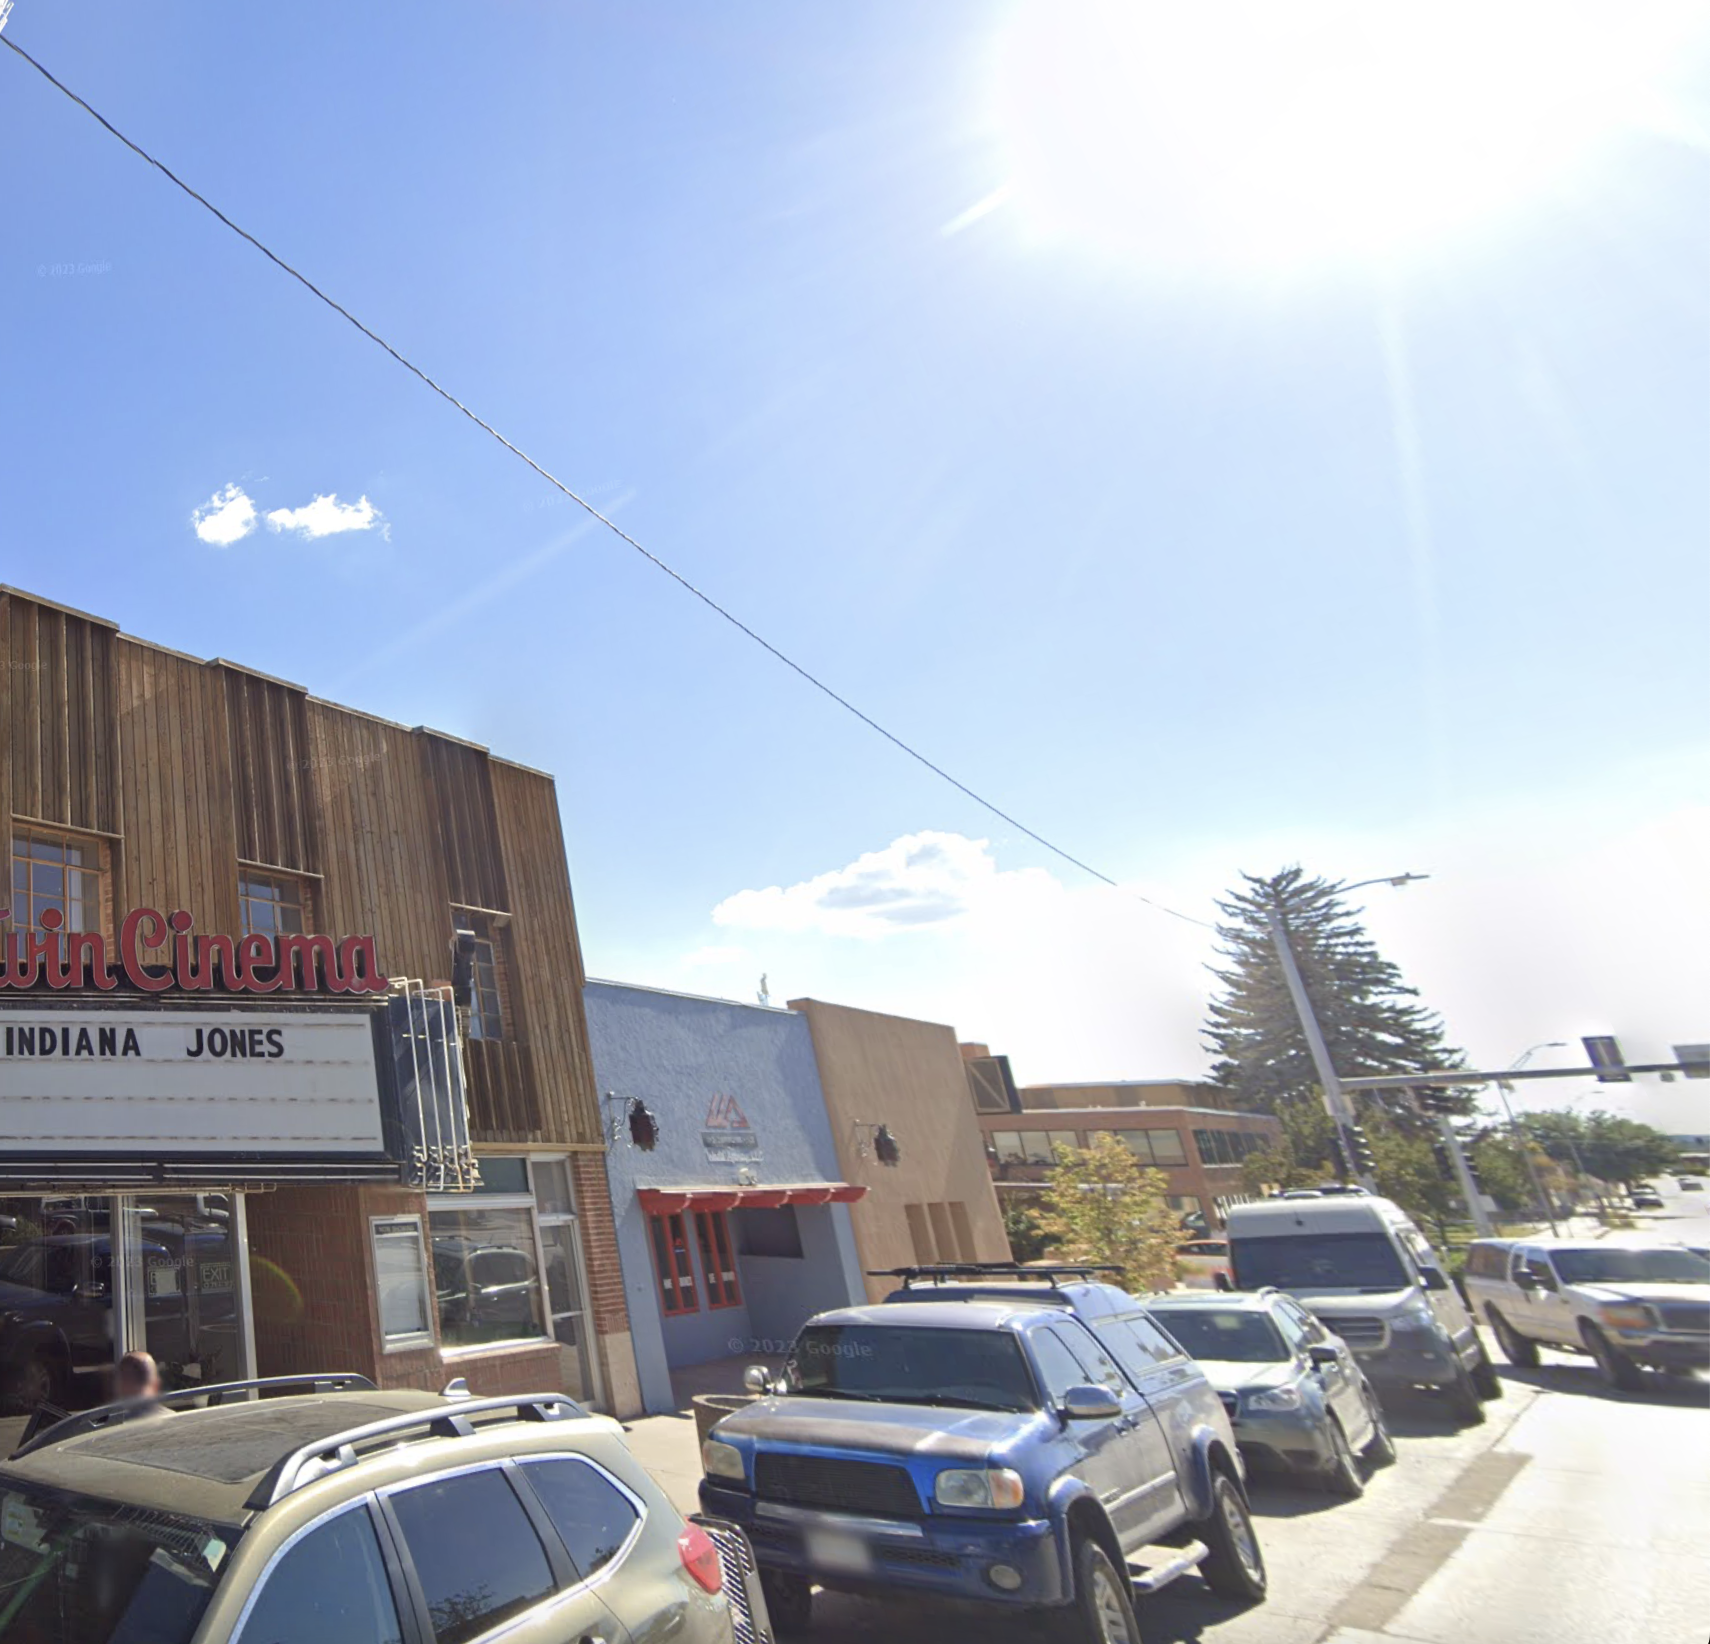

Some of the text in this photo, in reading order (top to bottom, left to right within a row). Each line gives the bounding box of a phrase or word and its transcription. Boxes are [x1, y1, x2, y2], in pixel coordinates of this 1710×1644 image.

[121, 907, 389, 994] Cinema
[5, 1026, 285, 1058] INDIANA JONES
[202, 1267, 229, 1282] EXIT
